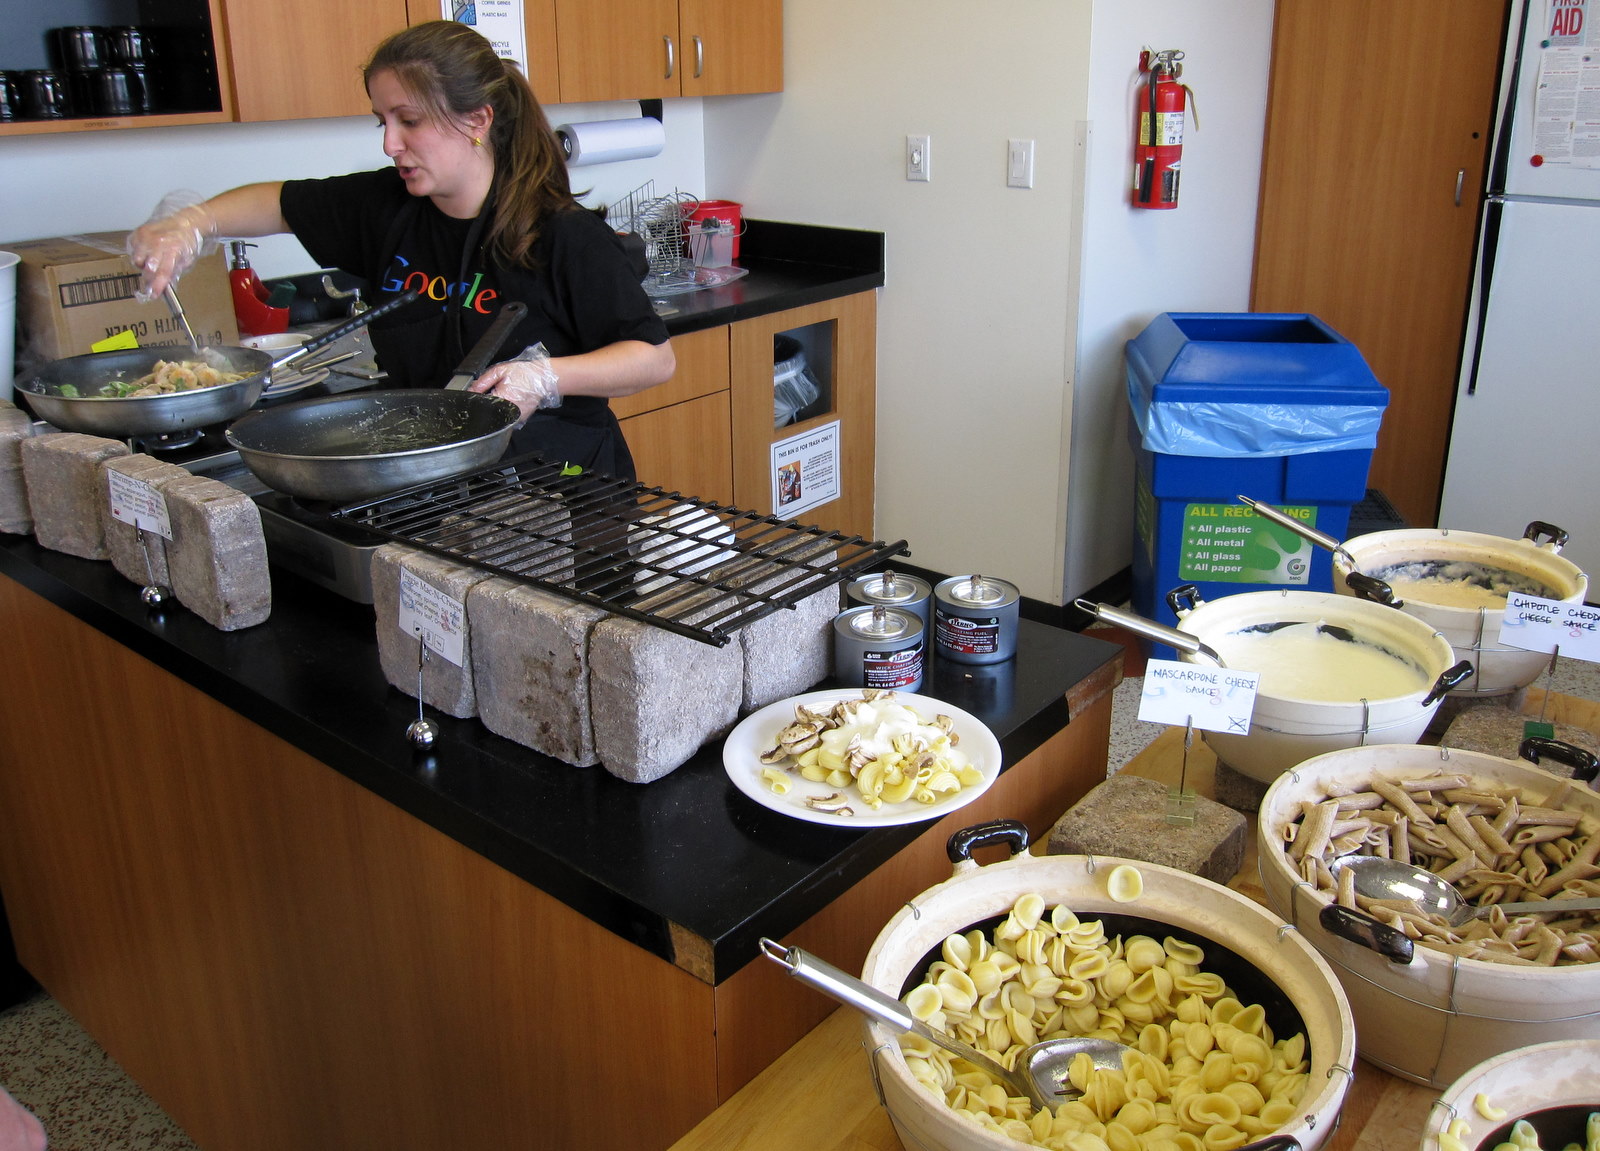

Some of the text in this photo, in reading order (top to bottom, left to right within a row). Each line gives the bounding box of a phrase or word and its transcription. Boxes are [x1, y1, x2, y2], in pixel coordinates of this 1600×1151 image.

[1550, 8, 1583, 36] AID
[800, 443, 808, 451] FOR
[808, 439, 820, 448] TRASH
[1190, 507, 1310, 519] ALL RECING
[1215, 525, 1252, 534] plastic
[1213, 539, 1245, 547] metal
[1212, 552, 1241, 561] glass
[1211, 565, 1243, 573] paper
[1514, 598, 1560, 614] CHIPOTLE
[1519, 612, 1552, 623] CHEESE
[1563, 620, 1597, 631] SAUCE
[1153, 668, 1256, 690] MASCARPONE CHEESE
[1186, 686, 1216, 697] SAUCE
